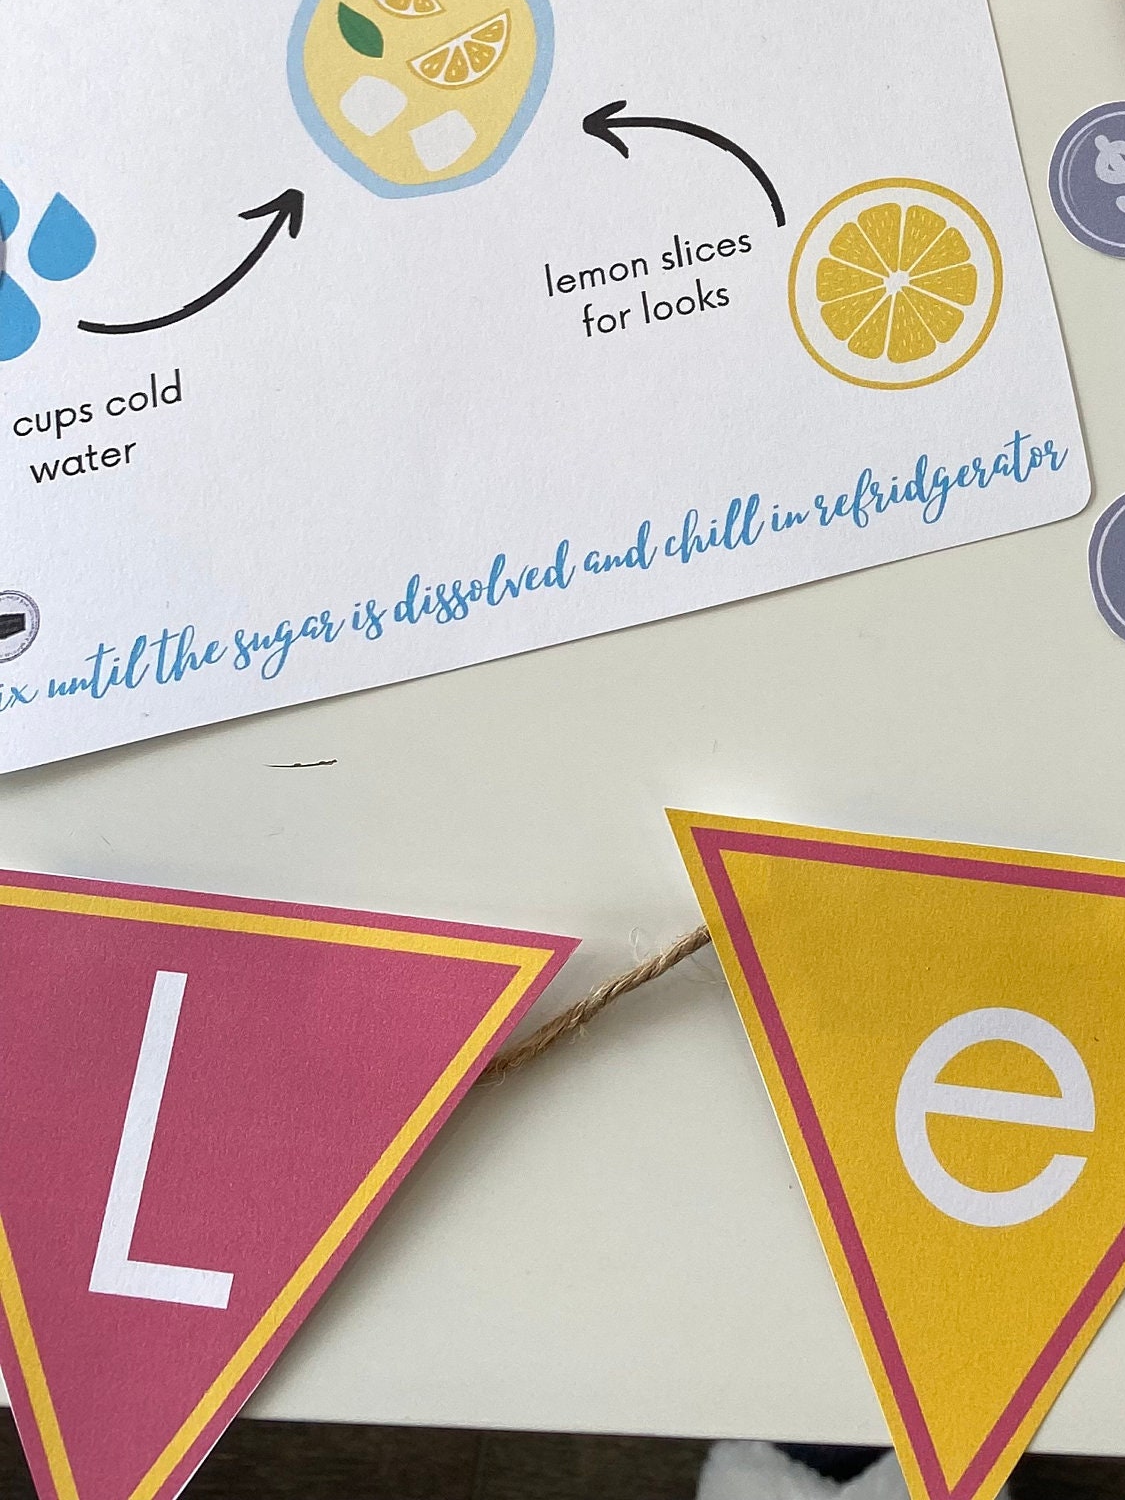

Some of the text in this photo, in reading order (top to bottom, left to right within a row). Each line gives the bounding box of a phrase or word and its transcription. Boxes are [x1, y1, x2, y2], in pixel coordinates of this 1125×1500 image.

[544, 233, 752, 298] lemon slices
[581, 278, 731, 338] for looks
[12, 367, 183, 440] cups cold
[29, 437, 137, 484] water
[48, 635, 149, 699] until
[150, 625, 228, 684] the
[234, 610, 345, 680] sugar
[352, 600, 387, 640] is
[394, 539, 576, 624] dissolved
[584, 520, 658, 575] and
[665, 493, 765, 563] chill
[771, 504, 810, 531] in
[814, 430, 1068, 524] refridgerator
